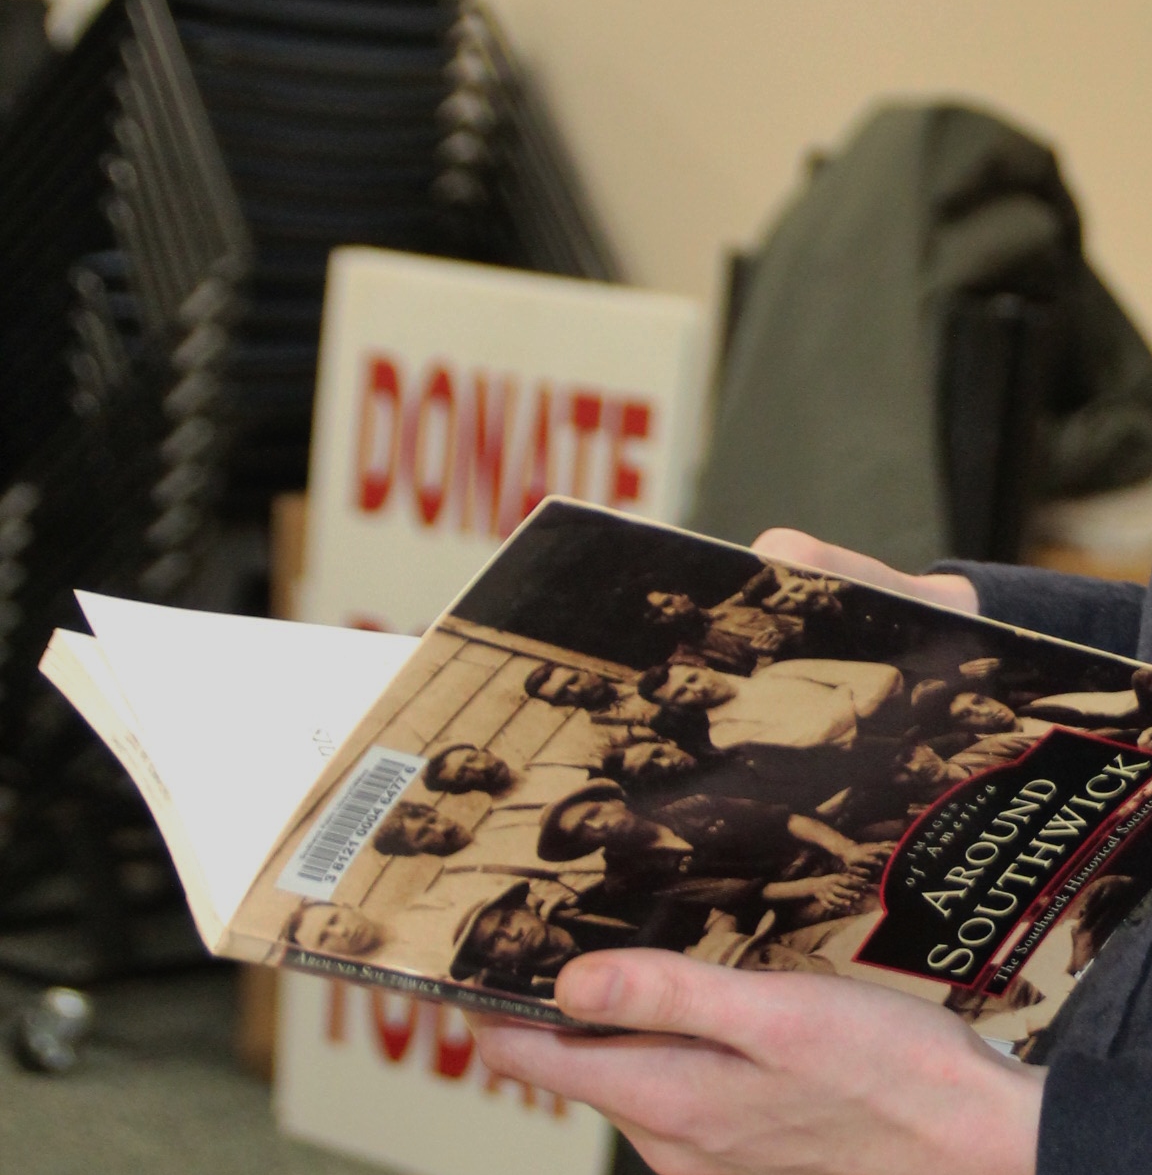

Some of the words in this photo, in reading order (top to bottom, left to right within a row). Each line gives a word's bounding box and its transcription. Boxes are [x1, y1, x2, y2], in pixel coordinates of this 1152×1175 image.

[357, 351, 651, 540] DONATE
[324, 874, 337, 883] 3
[356, 807, 384, 837] 0004
[905, 865, 926, 887] of
[926, 784, 997, 859] America
[907, 802, 959, 859] IMAGES
[921, 778, 1057, 918] AROUND
[927, 753, 1151, 976] SOUTHWICK
[993, 957, 1019, 981] The
[1014, 894, 1069, 954] Southwick
[1064, 835, 1120, 892] Historical
